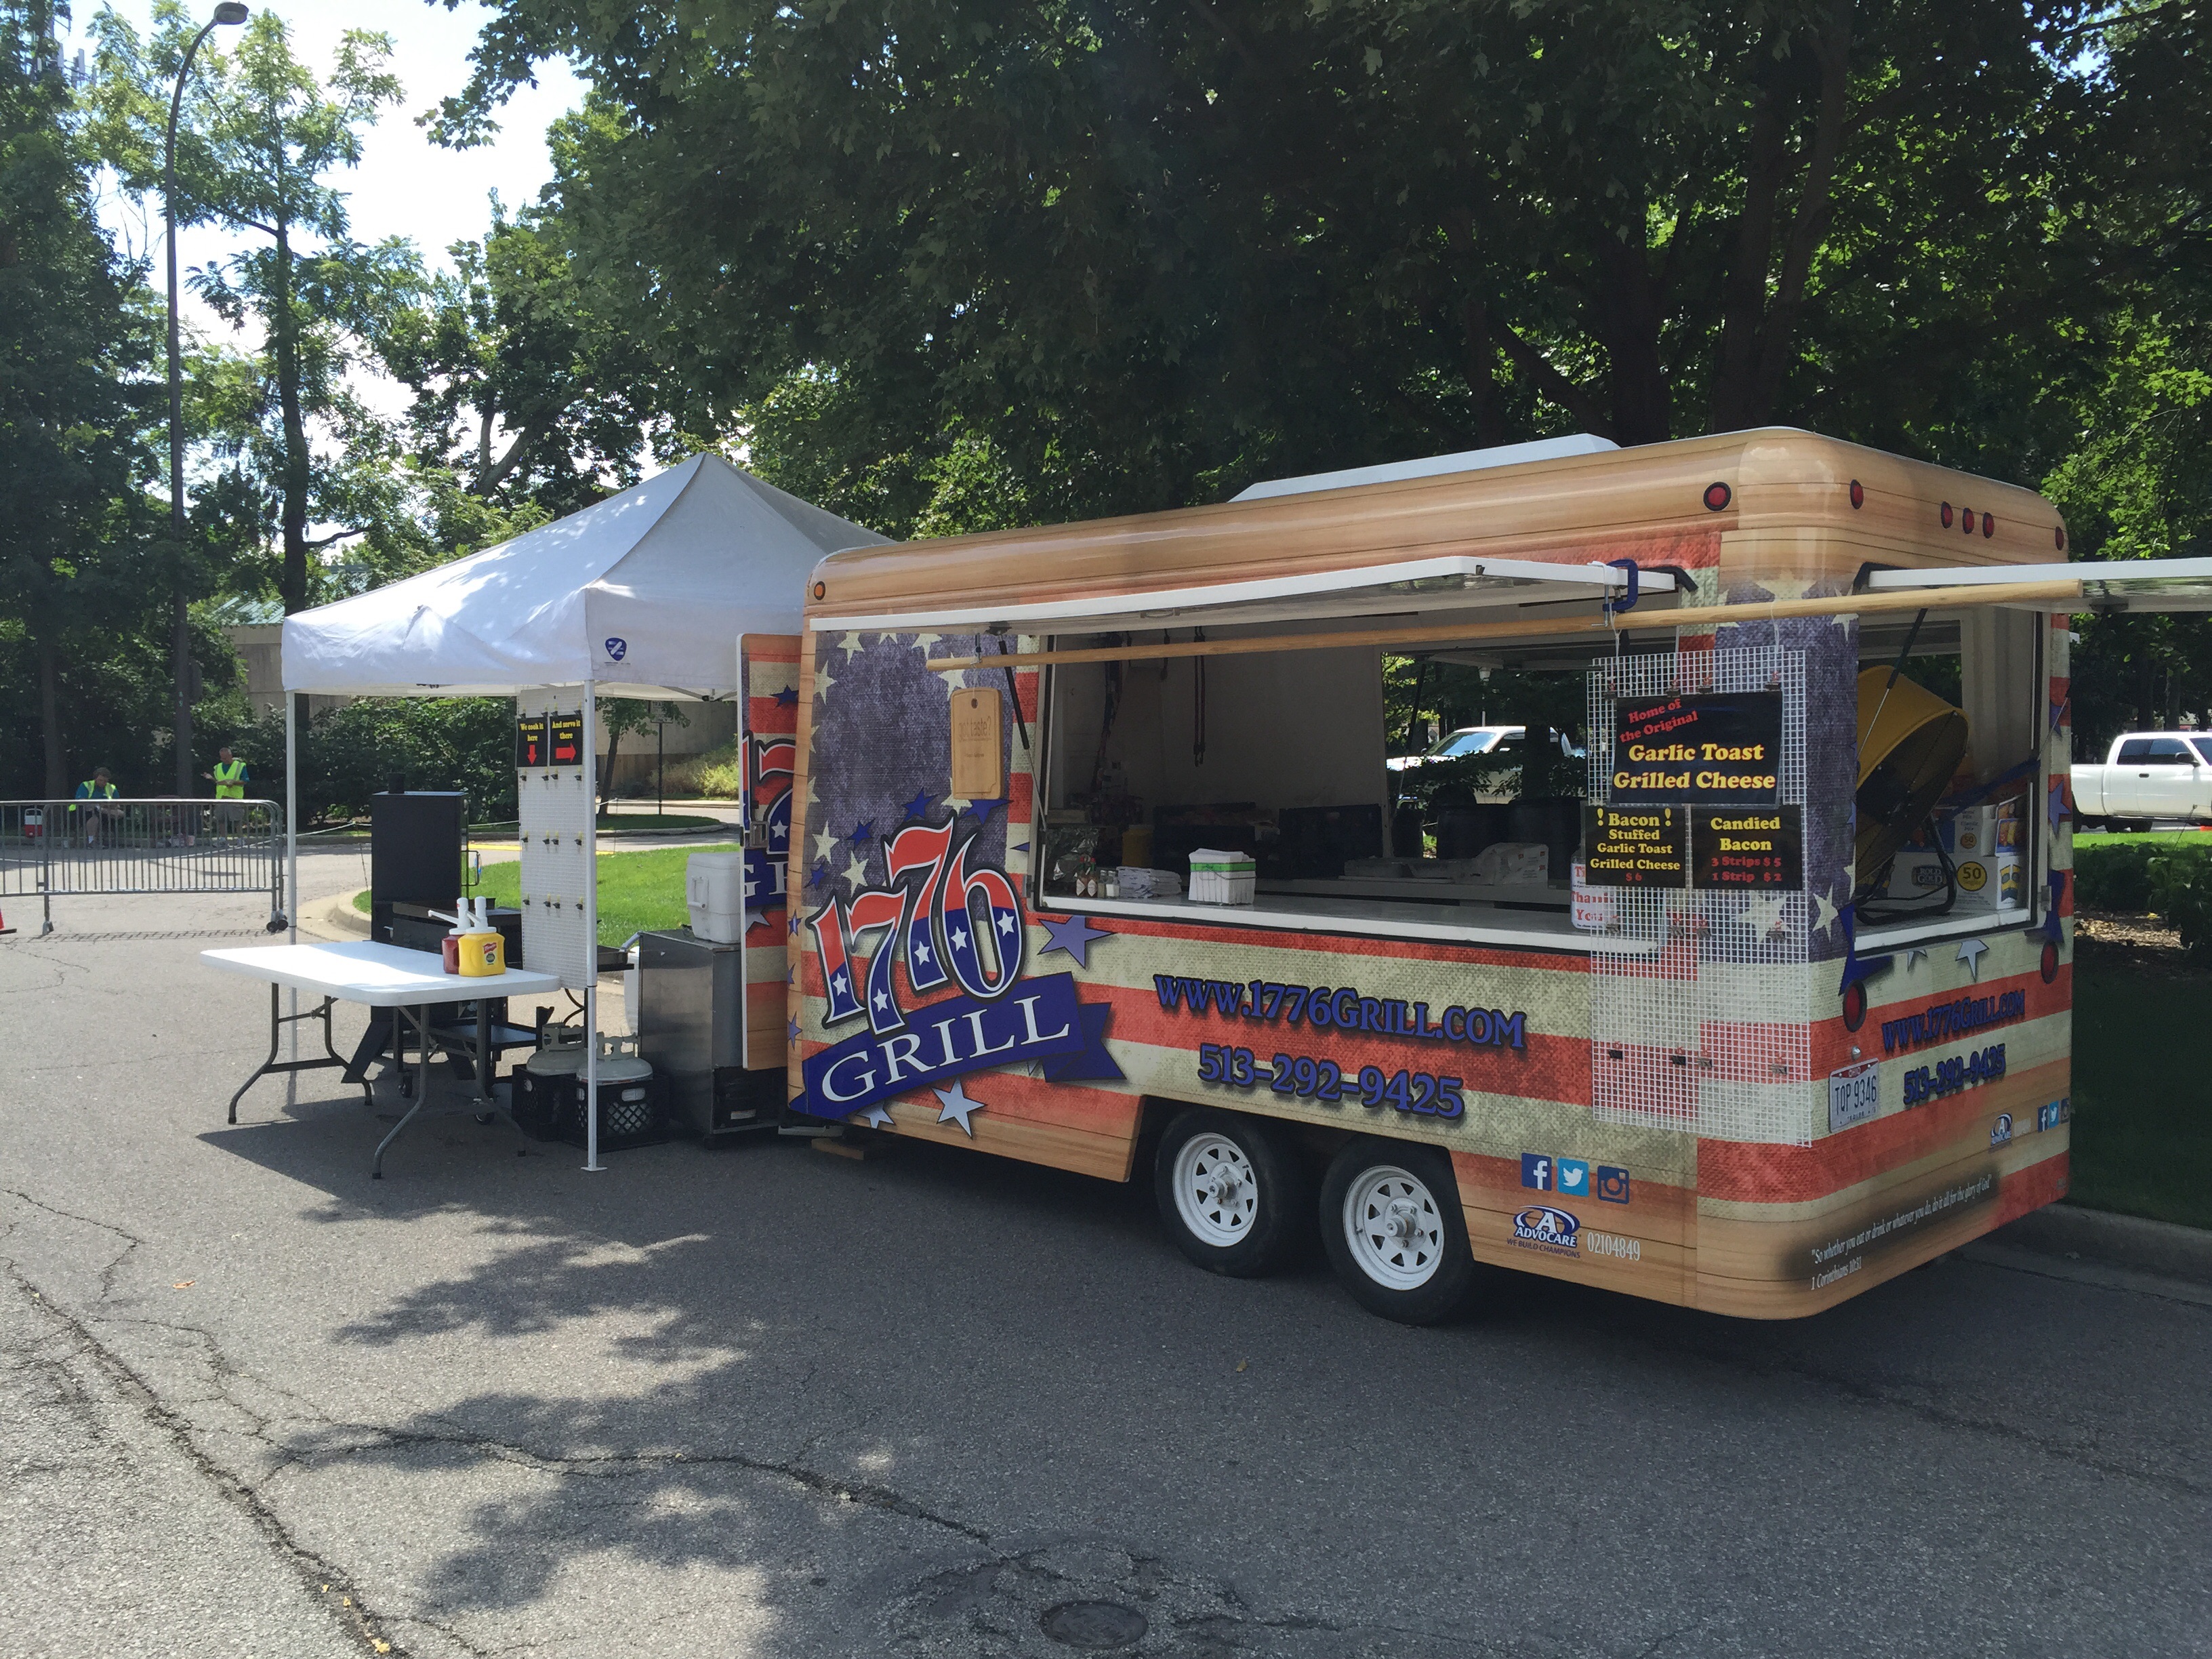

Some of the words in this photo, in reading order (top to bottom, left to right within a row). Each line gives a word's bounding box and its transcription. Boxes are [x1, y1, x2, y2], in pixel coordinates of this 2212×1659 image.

[1628, 705, 1665, 723] Home
[1667, 698, 1682, 711] of
[1619, 728, 1641, 743] the
[1643, 710, 1698, 735] Original
[1629, 744, 1696, 761] Garlic
[1701, 743, 1765, 760] Toast
[1614, 771, 1690, 789] Grilled
[1696, 771, 1776, 789] Cheese
[1608, 813, 1660, 826] Bacon
[1711, 817, 1781, 830] Candied
[1609, 829, 1660, 840] Stuffed
[1719, 838, 1772, 851] Bacon
[1597, 842, 1635, 853] Garlic
[1638, 843, 1673, 853] Toast
[1590, 858, 1634, 869] Grilled
[1637, 859, 1681, 869] Cheese
[1711, 857, 1719, 866] 3
[1722, 856, 1761, 867] Strips
[1763, 857, 1771, 866] $
[1774, 857, 1782, 867] 5
[1713, 872, 1719, 880] 1
[1722, 871, 1755, 882] Strip
[1763, 872, 1771, 882] $
[1774, 873, 1782, 881] 2
[1963, 867, 1981, 880] 50
[810, 815, 1023, 1036] 1776
[822, 995, 1070, 1102] GRILL
[1198, 1044, 1463, 1119] 513-292-9425
[1904, 1043, 2006, 1105] 513-292-9425
[1854, 1076, 1877, 1109] 9346
[1824, 1239, 1845, 1260] whether
[1845, 1237, 1856, 1256] you
[1856, 1231, 1865, 1246] eat
[1865, 1230, 1871, 1242] or
[1871, 1218, 1885, 1239] drink
[1885, 1221, 1892, 1233] or
[1893, 1212, 1914, 1229] whatever
[1914, 1207, 1924, 1225] you
[1949, 1189, 1957, 1209] for
[1515, 1226, 1577, 1248] ADVOCARE
[1587, 1232, 1641, 1261] 02104849
[1507, 1238, 1517, 1246] WE
[1518, 1240, 1538, 1250] BUILD
[1539, 1244, 1581, 1258] CHAMPIONS
[1811, 1277, 1815, 1290] 1
[1817, 1265, 1848, 1288] Corinthians
